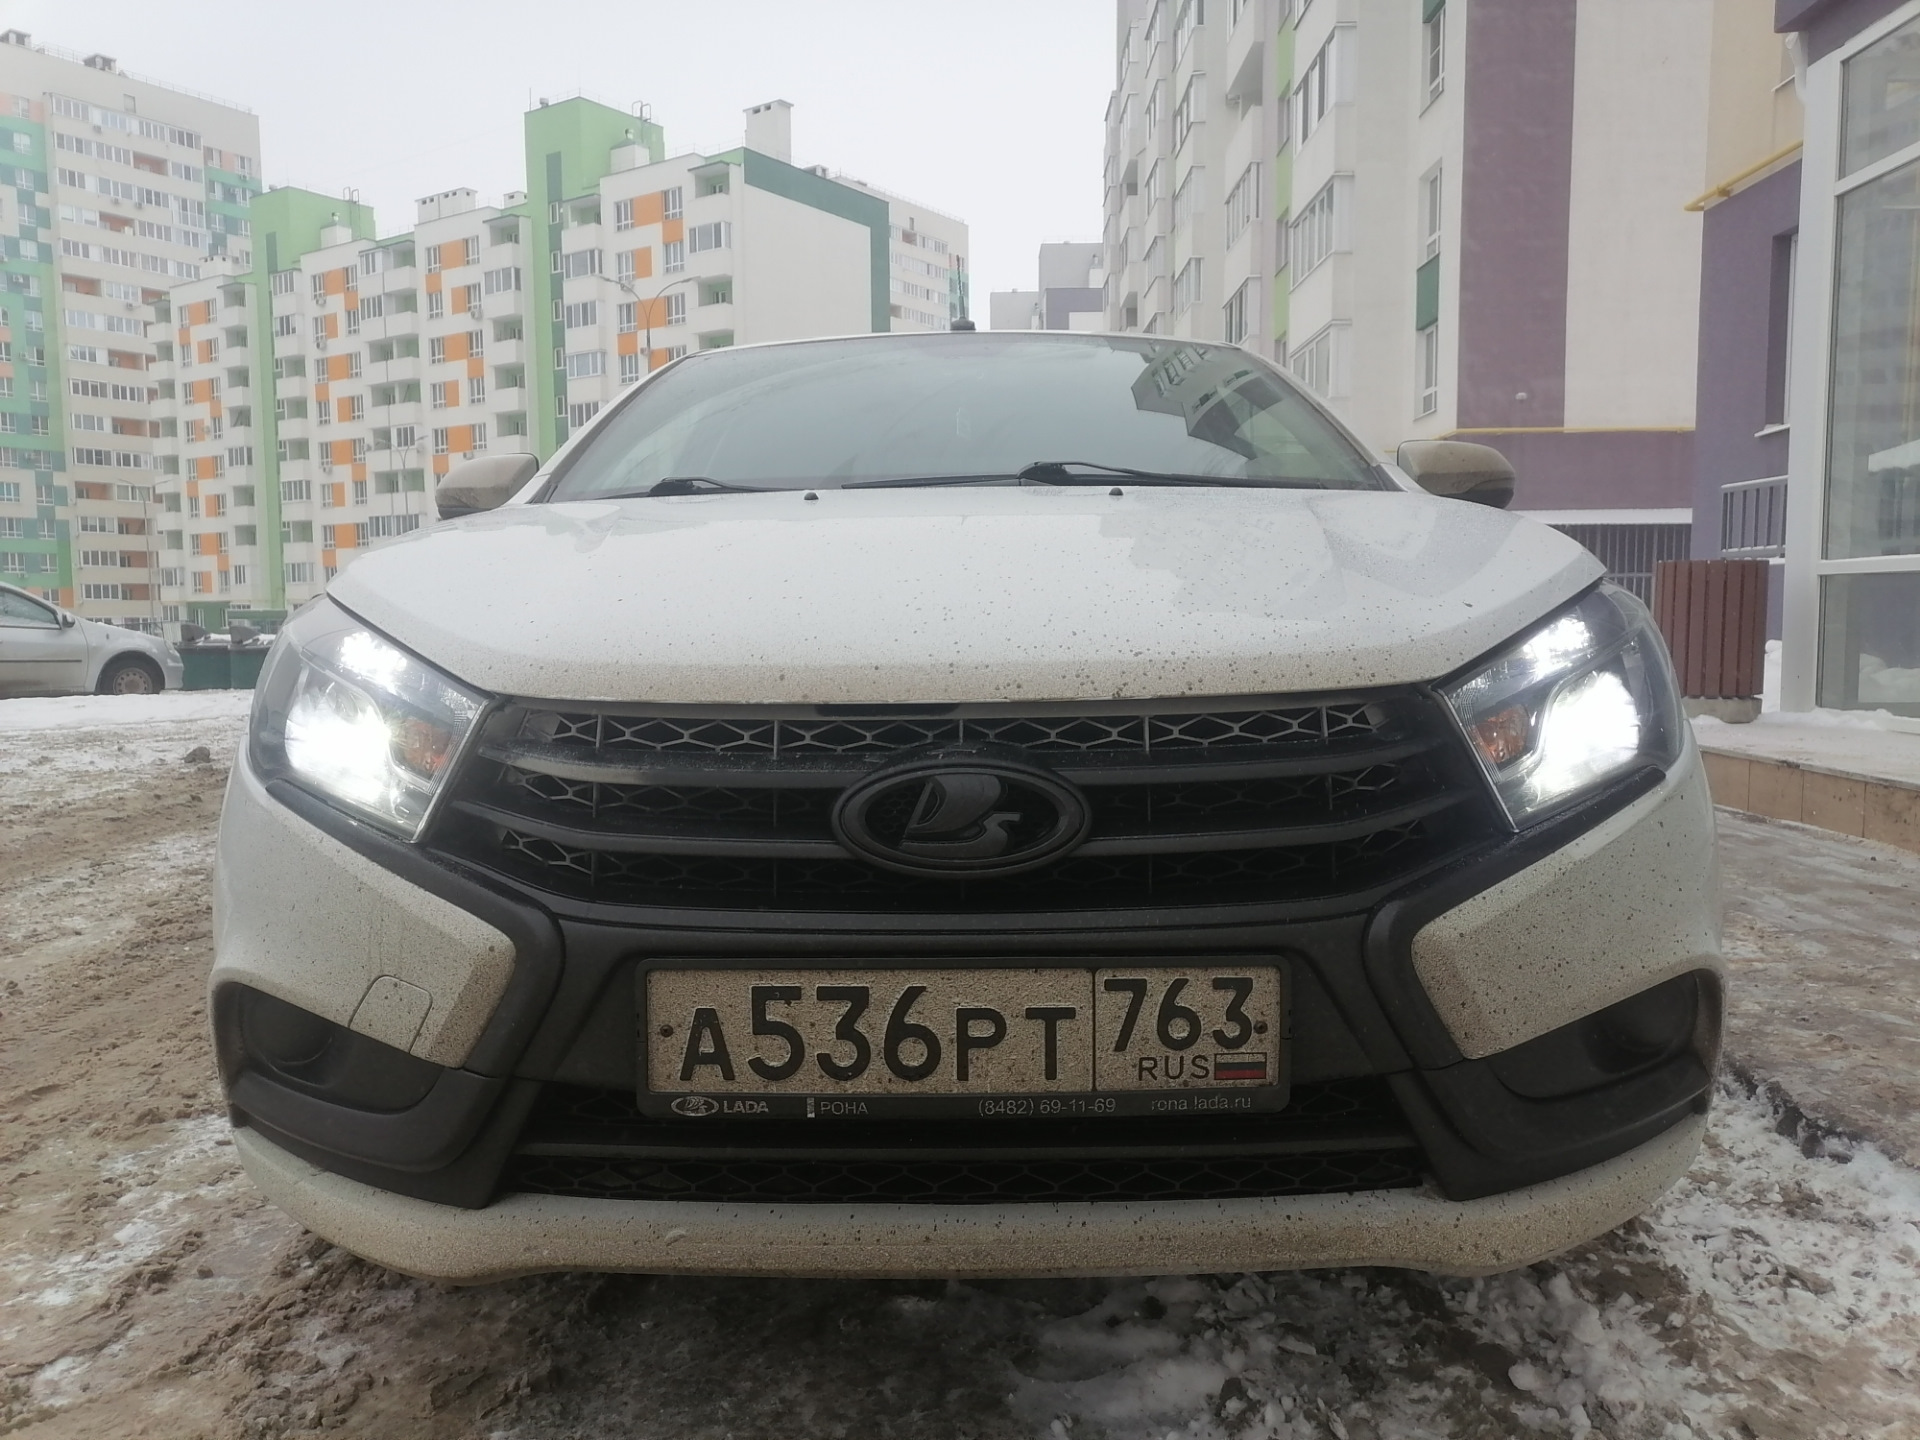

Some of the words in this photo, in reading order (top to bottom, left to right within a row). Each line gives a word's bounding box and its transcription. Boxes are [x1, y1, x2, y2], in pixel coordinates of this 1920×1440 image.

[1103, 976, 1254, 1053] 763
[1138, 1054, 1211, 1082] RUS
[723, 1100, 769, 1114] LADA
[820, 1101, 869, 1115] РОНА
[978, 1098, 1035, 1117] (8482)
[1039, 1098, 1117, 1114] 69-11-69
